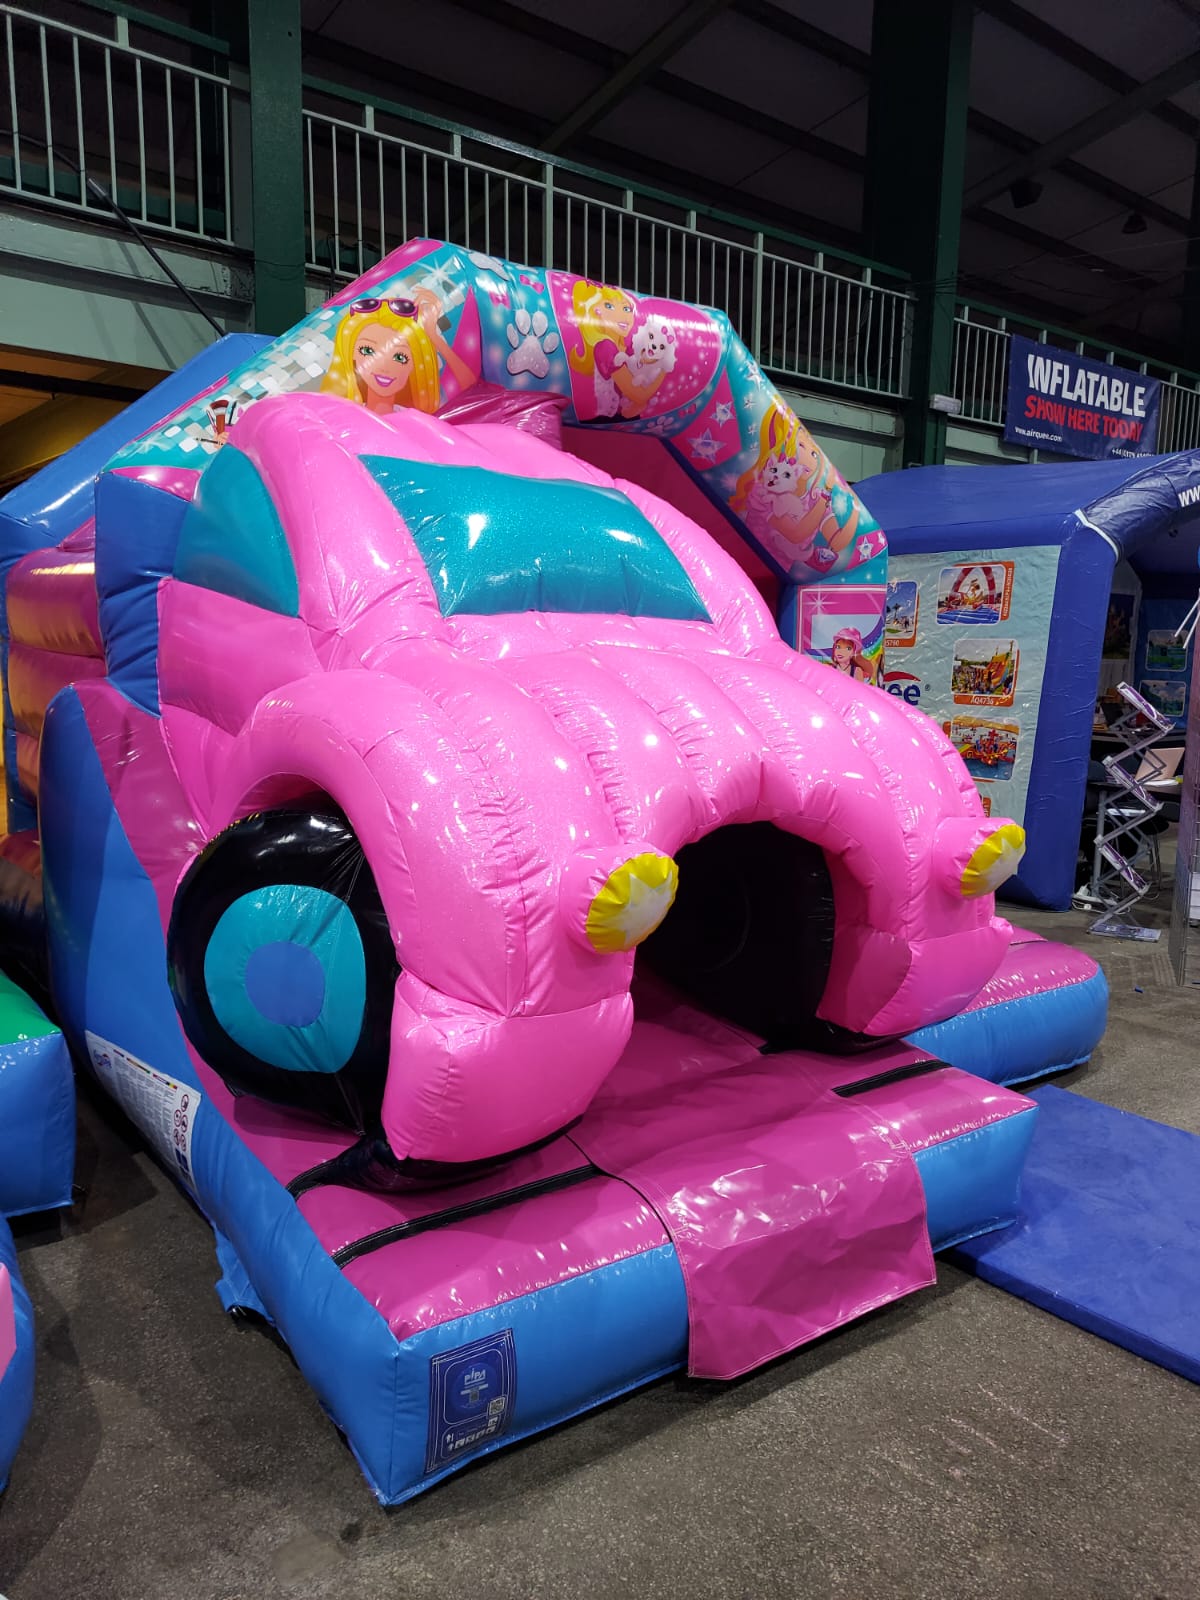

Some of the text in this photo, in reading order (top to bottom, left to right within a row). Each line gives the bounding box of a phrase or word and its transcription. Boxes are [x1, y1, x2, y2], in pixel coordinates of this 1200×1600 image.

[1028, 354, 1146, 418] INFLATABLE
[1024, 395, 1143, 443] SHOW HERE TODAY
